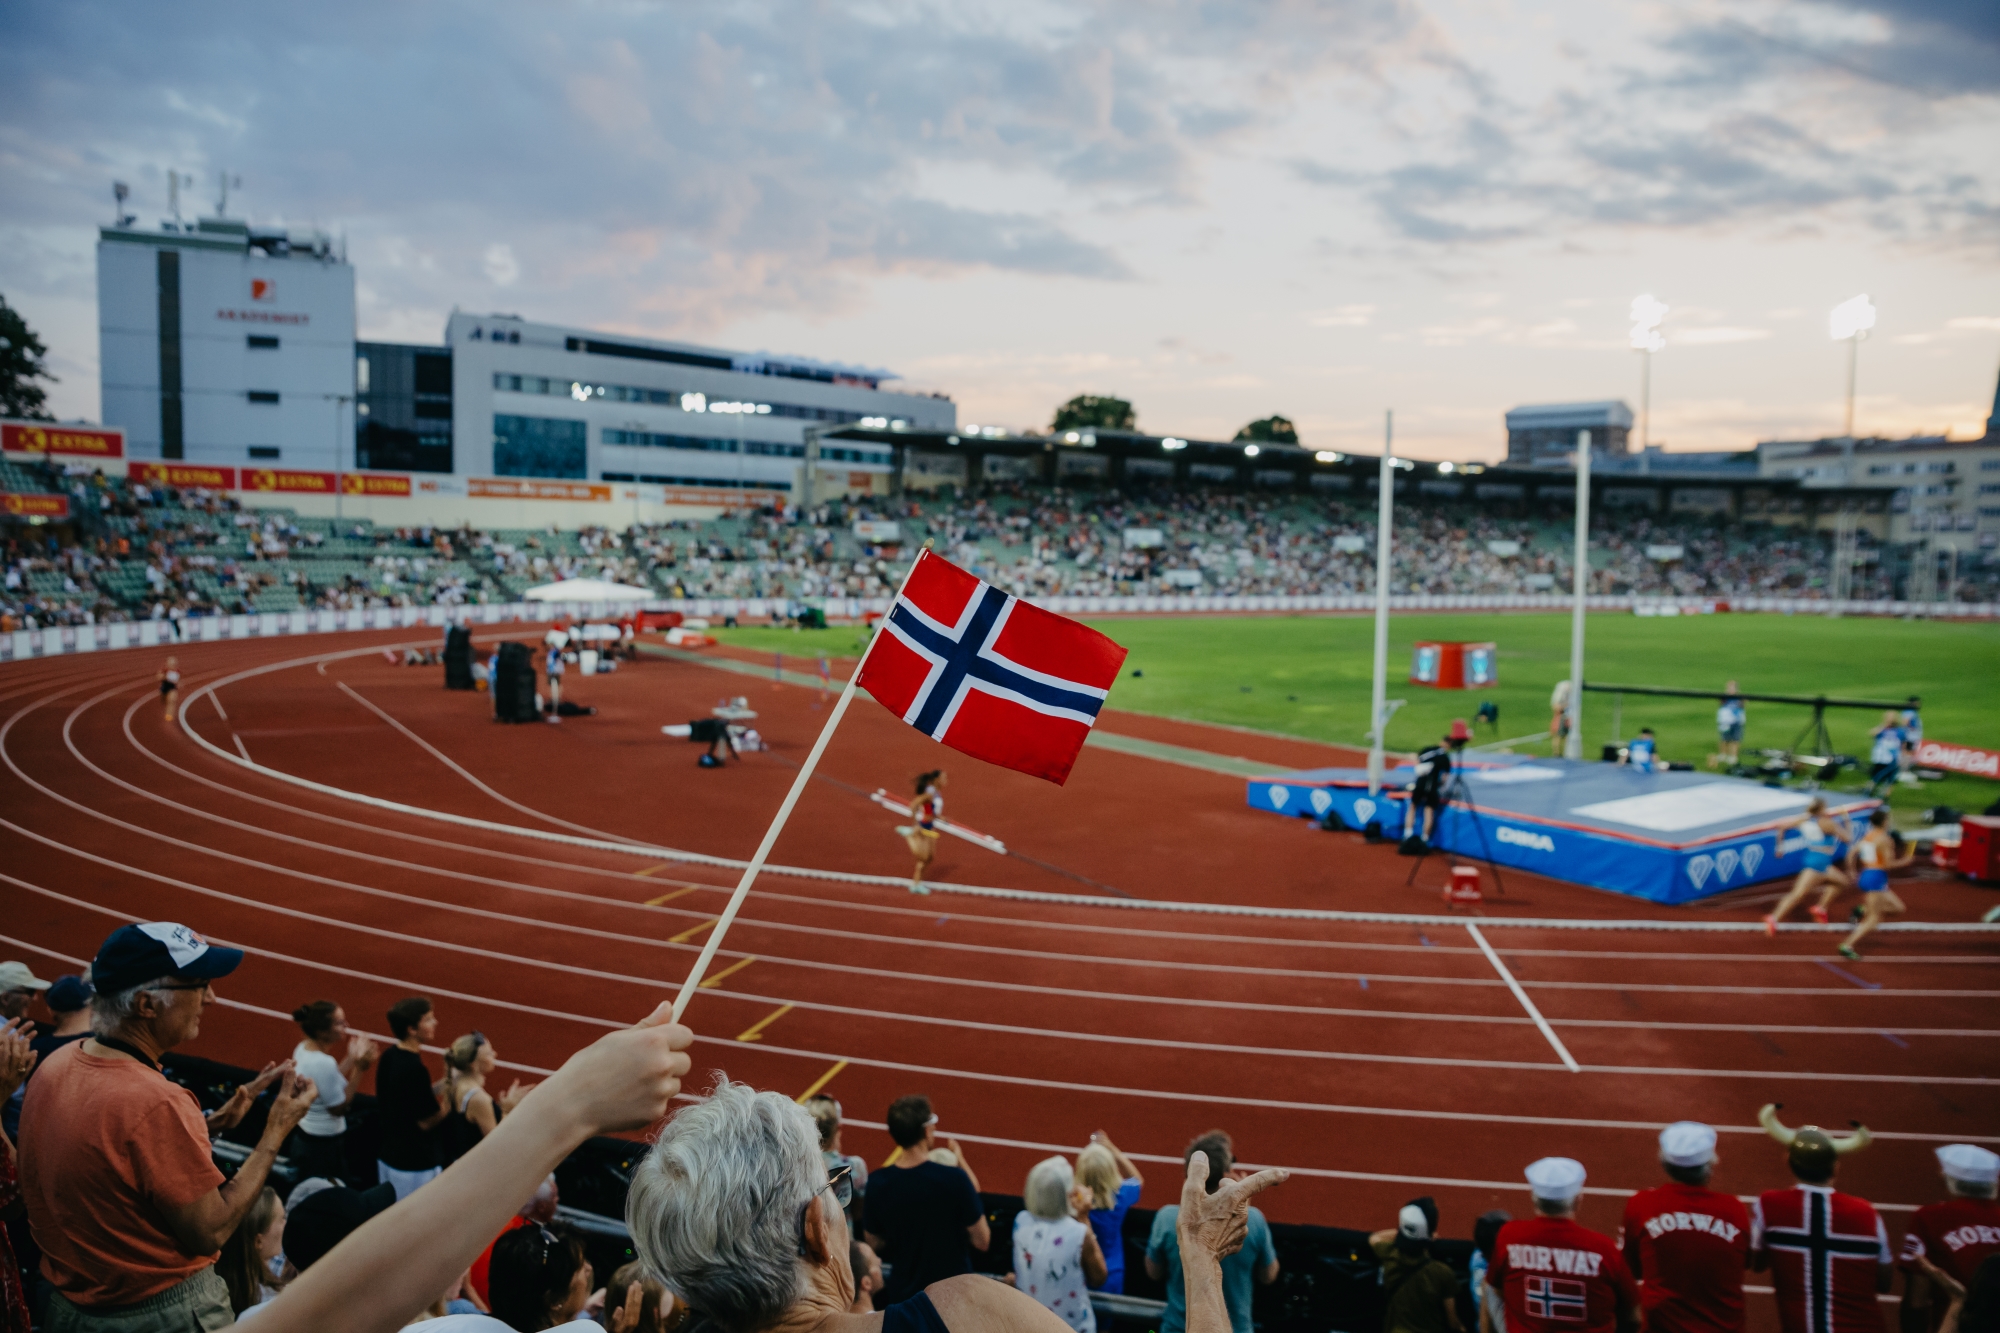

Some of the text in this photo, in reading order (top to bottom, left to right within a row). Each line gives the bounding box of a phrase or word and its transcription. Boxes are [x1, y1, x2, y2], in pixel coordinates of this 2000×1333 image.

[51, 433, 109, 452] EXTRA
[171, 469, 224, 485] EXTRA
[279, 474, 327, 489] EXTRA
[366, 478, 409, 493] EXTRA
[1920, 743, 1999, 776] OMEGA
[1644, 1211, 1741, 1243] NORWAY
[1506, 1244, 1603, 1277] NORWAY
